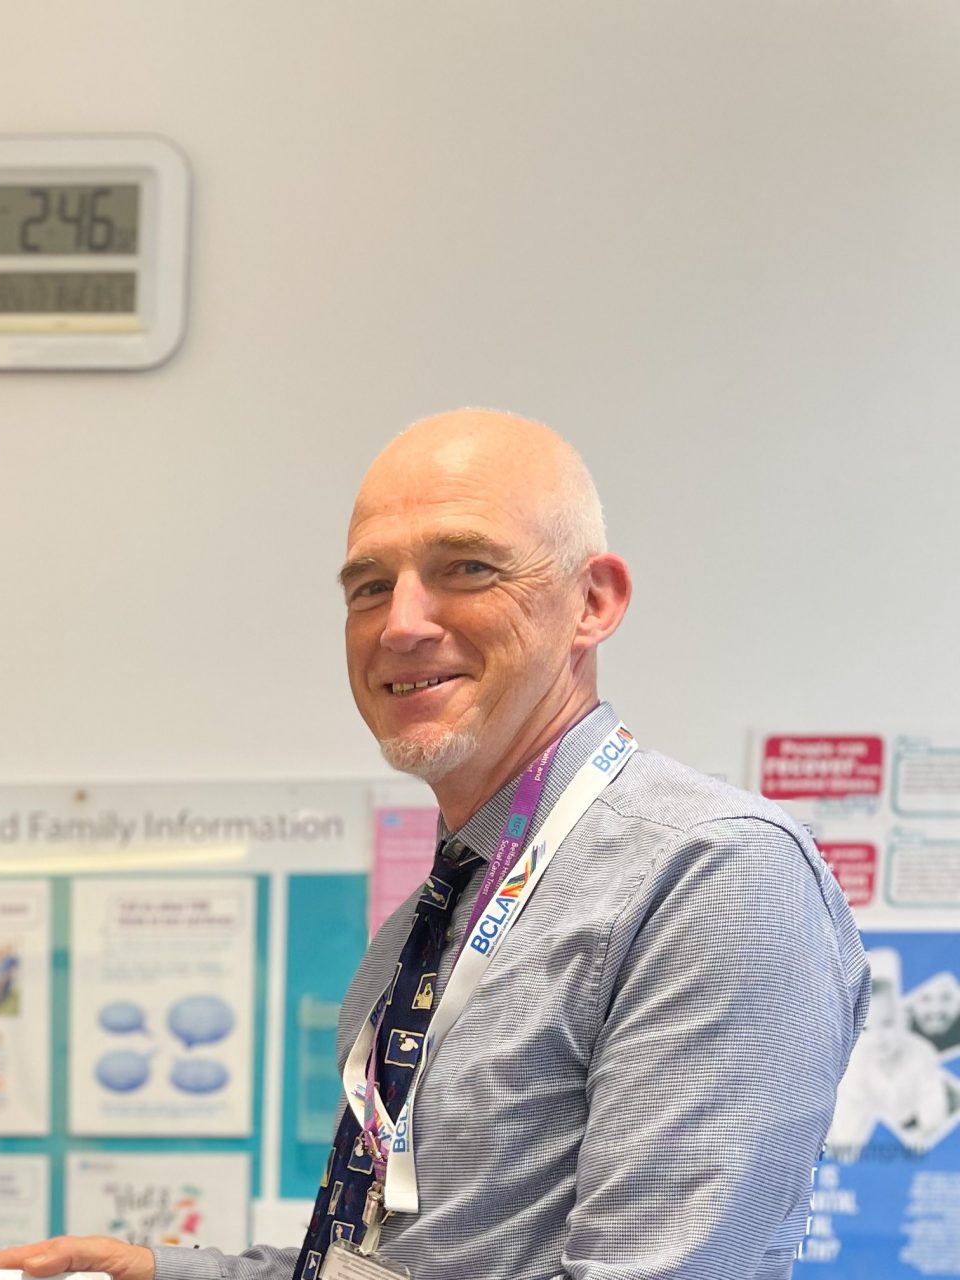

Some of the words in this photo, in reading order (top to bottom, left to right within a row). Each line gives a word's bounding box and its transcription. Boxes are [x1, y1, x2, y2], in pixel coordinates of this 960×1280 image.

[592, 731, 630, 773] BCLA
[27, 811, 136, 848] Family
[143, 808, 345, 841] Information
[495, 840, 509, 861] Social
[489, 861, 501, 878] Care
[482, 877, 494, 896] Trust
[470, 897, 516, 955] BCLA
